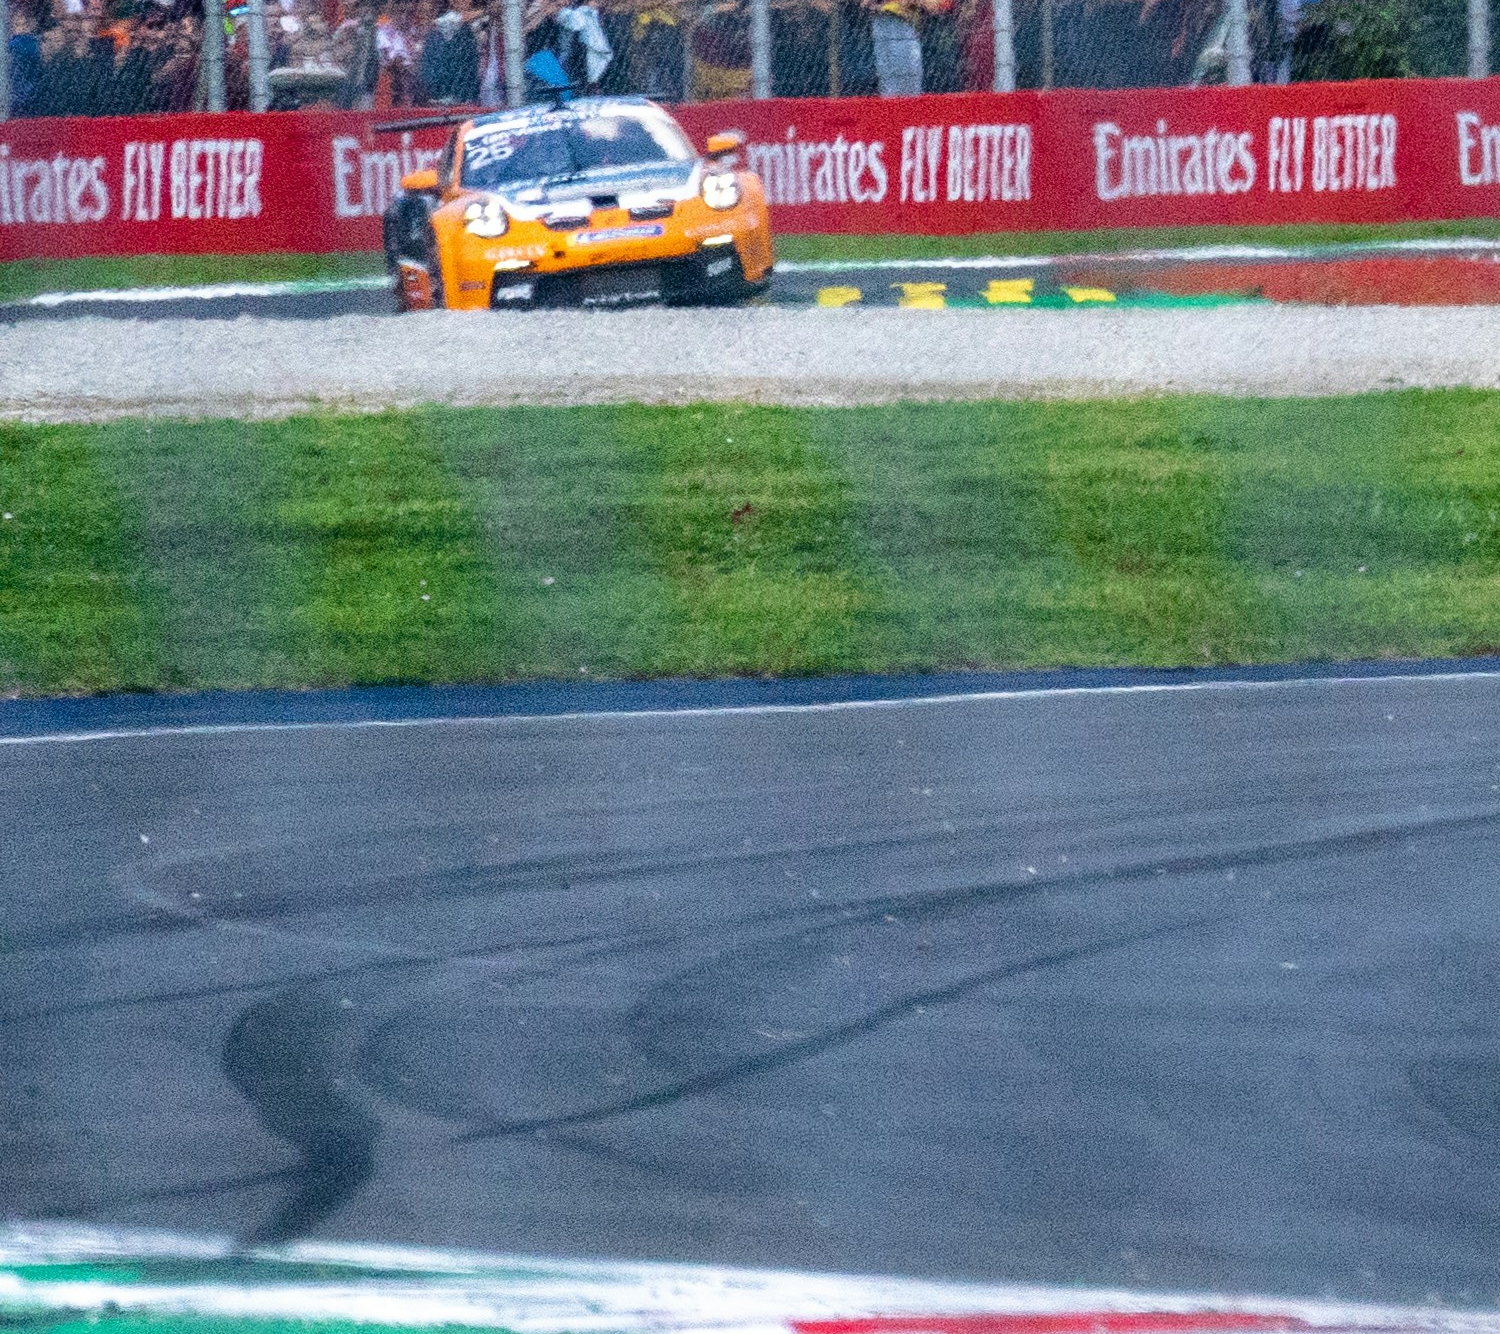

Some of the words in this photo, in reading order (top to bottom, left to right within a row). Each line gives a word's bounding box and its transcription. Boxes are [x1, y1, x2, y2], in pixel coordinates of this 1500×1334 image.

[123, 142, 164, 221] FLY
[170, 138, 263, 219] BETTER
[745, 125, 888, 204] mirates
[900, 126, 943, 203] FLY
[948, 124, 1032, 201] BETTER
[1094, 119, 1257, 201] Emirates
[1268, 115, 1305, 194] FLY
[1312, 113, 1398, 193] BETTER
